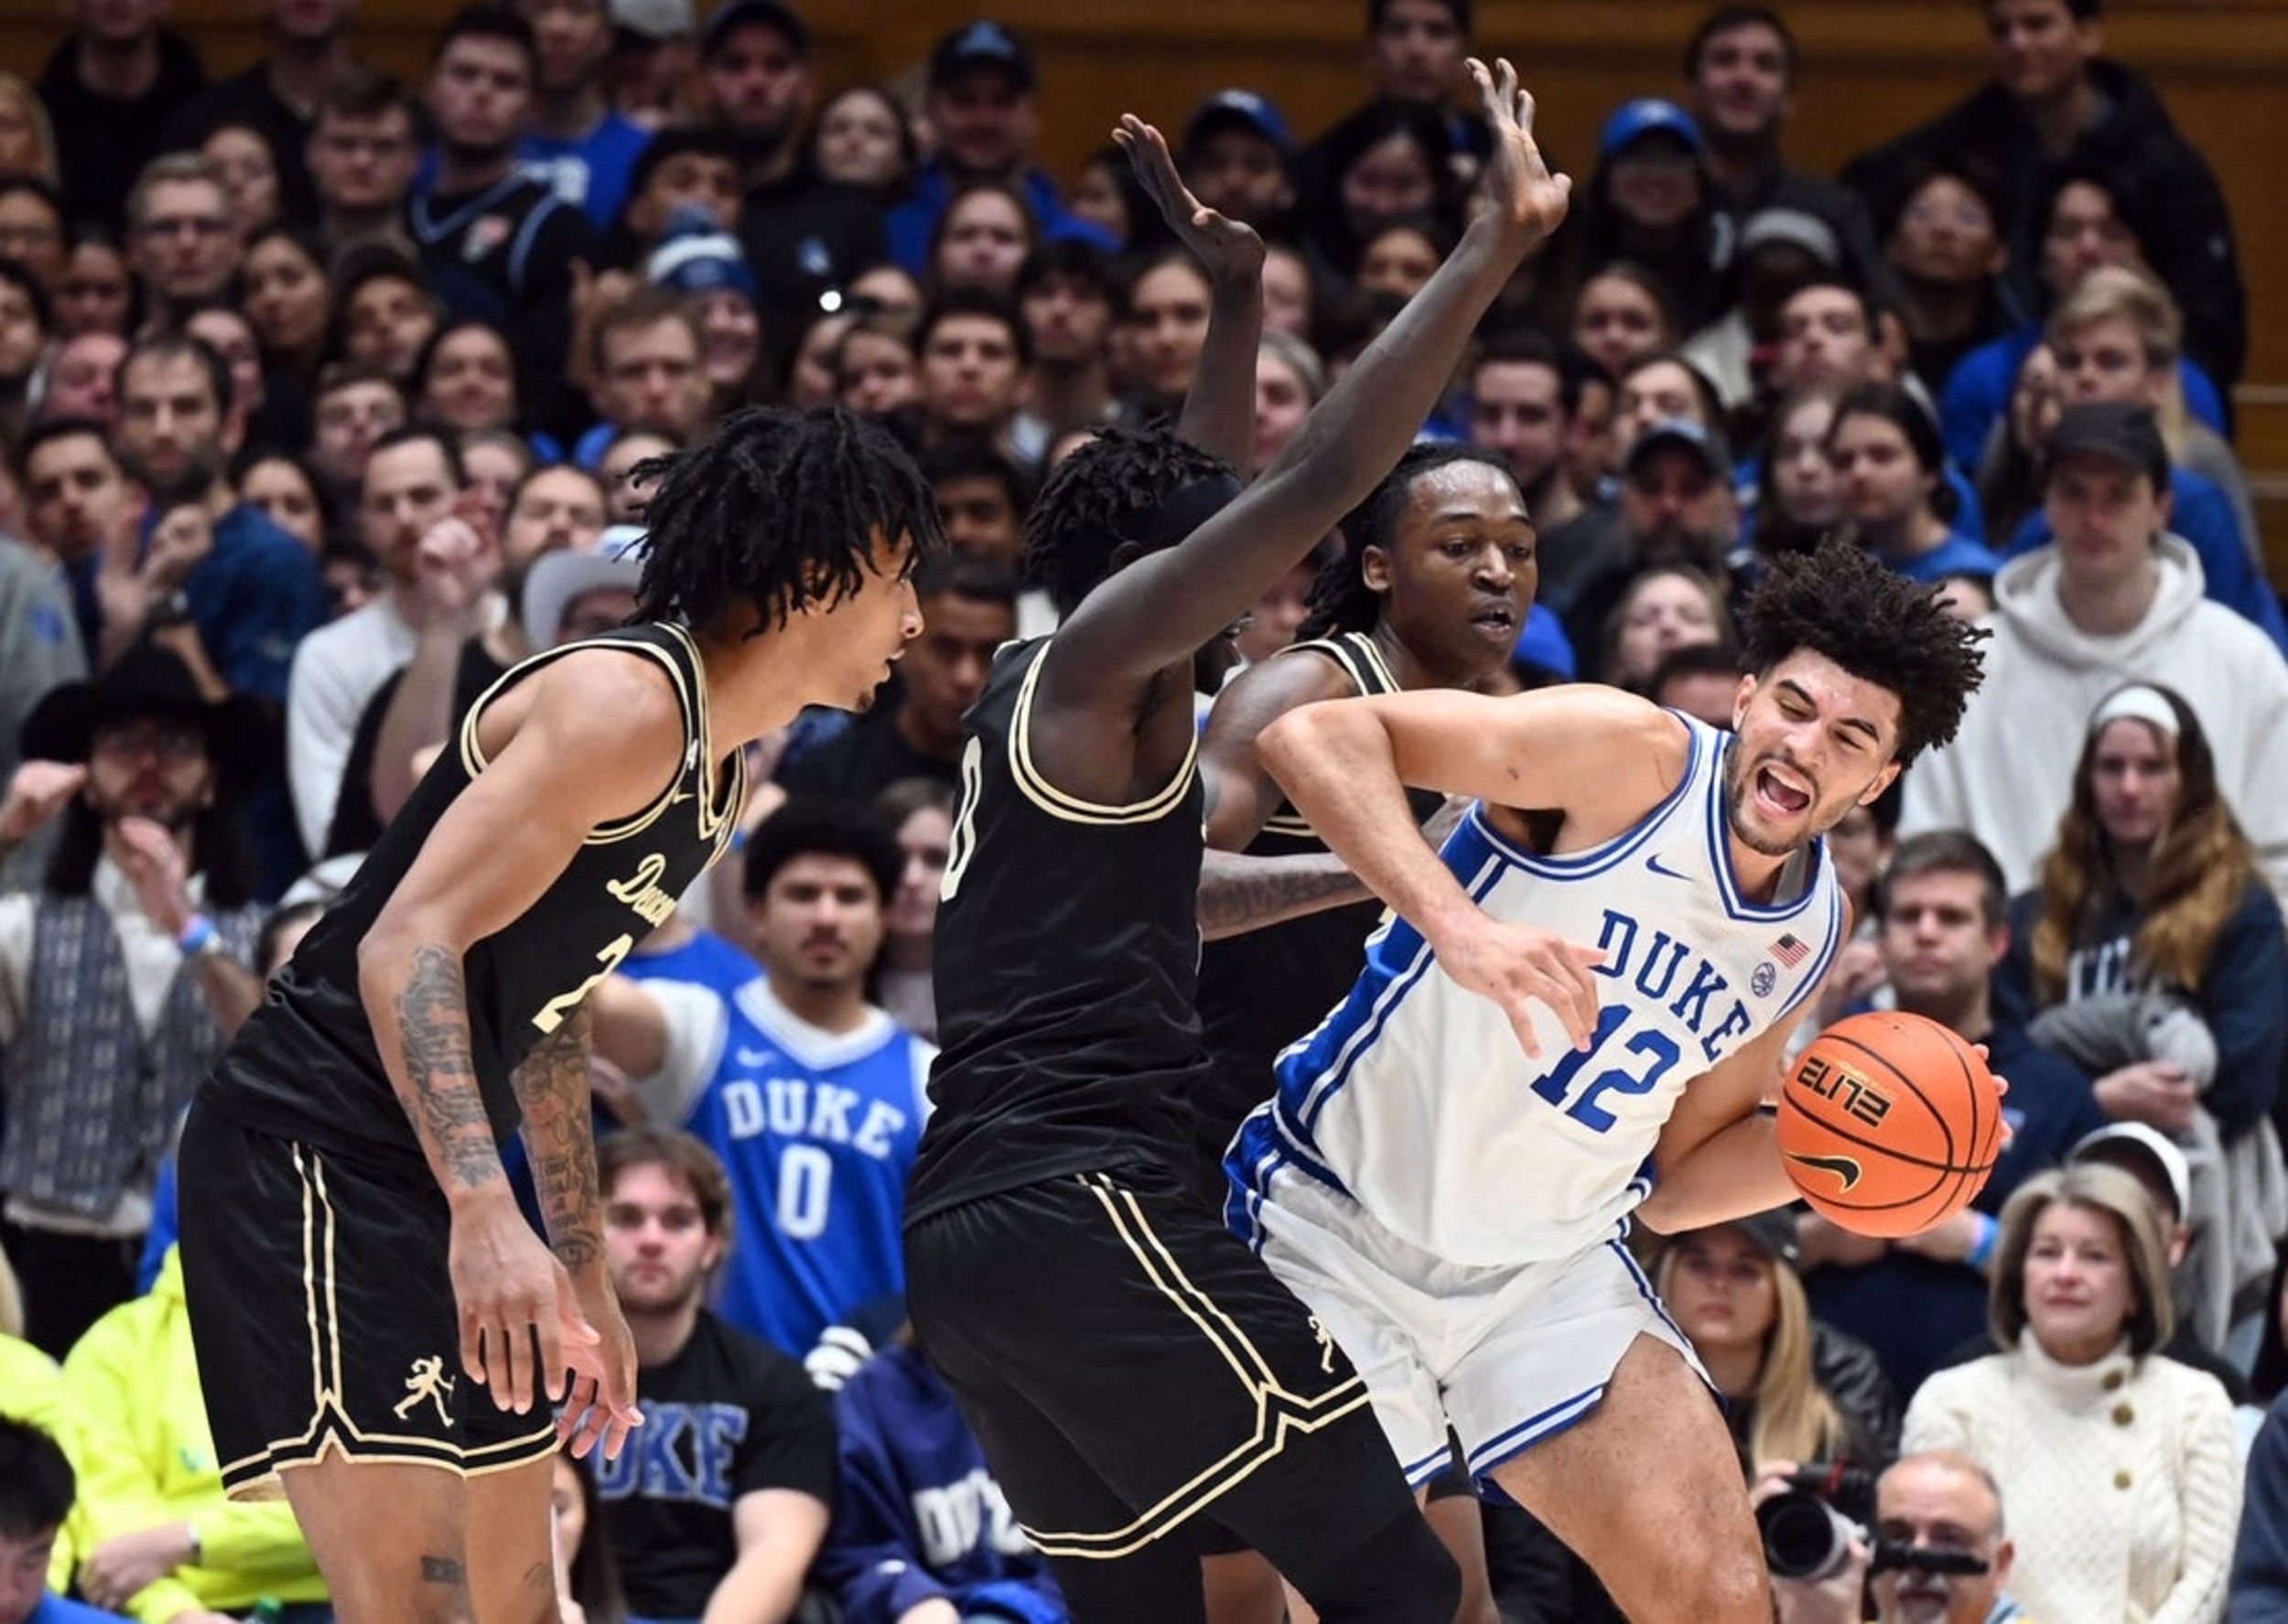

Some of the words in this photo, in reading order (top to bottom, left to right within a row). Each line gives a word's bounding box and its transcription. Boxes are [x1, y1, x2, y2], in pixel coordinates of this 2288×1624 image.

[940, 736, 982, 902] 0
[532, 933, 633, 1033] 2
[1589, 909, 1752, 1063] DUKE
[722, 1079, 906, 1159] DUKE
[1530, 1004, 1680, 1134] 12
[1797, 1056, 1891, 1128] ELITE
[777, 1144, 832, 1241] 0
[555, 1398, 750, 1508] UKE
